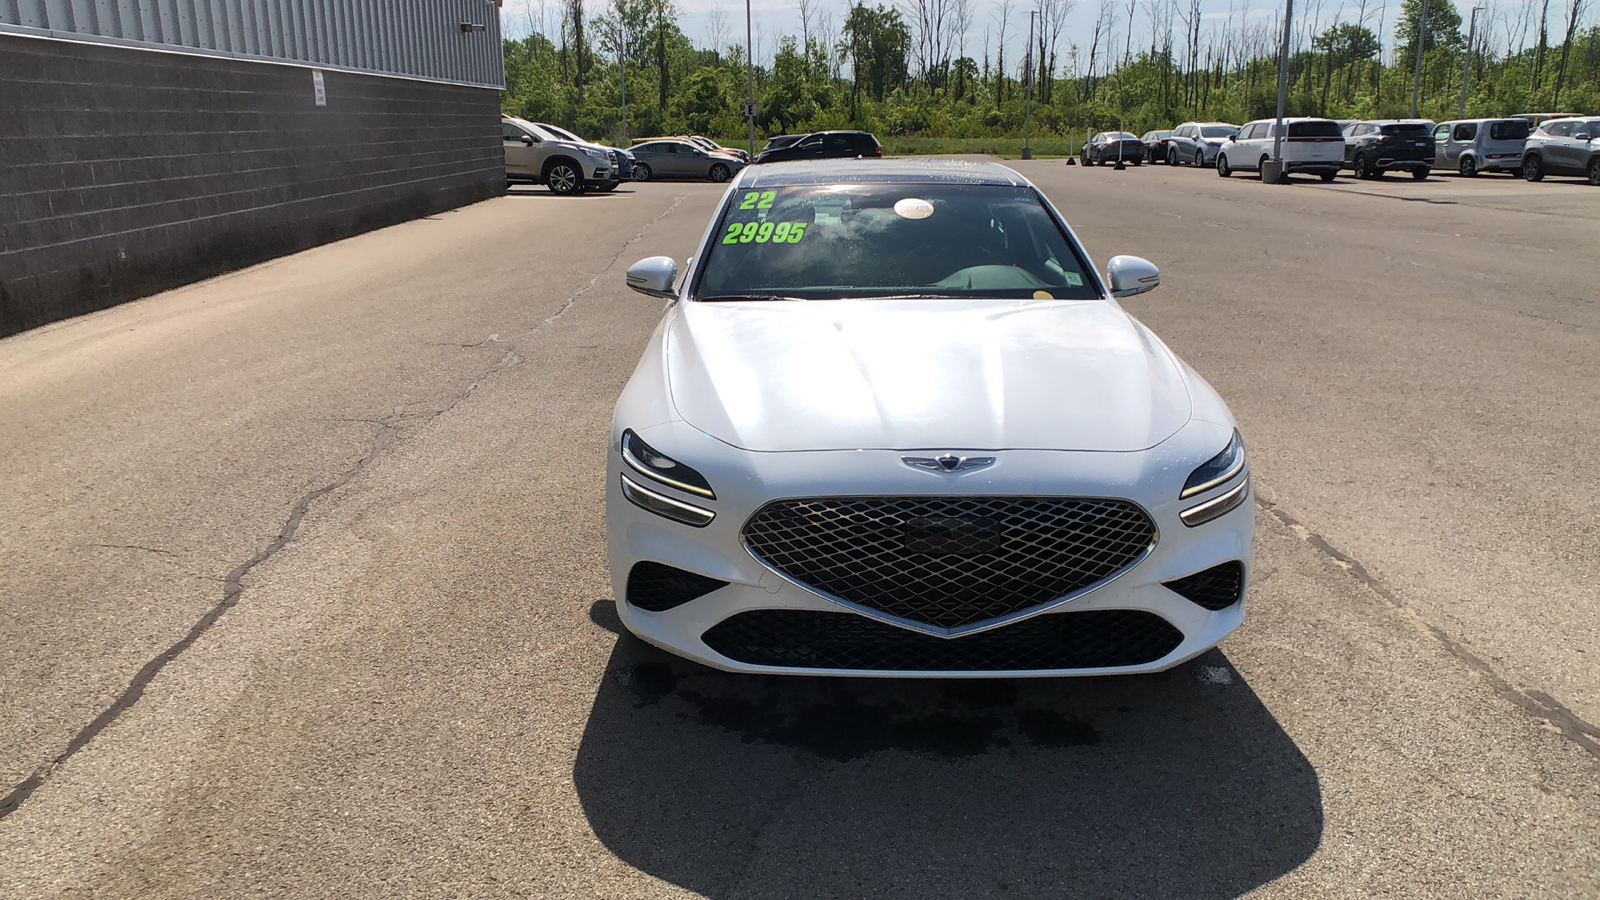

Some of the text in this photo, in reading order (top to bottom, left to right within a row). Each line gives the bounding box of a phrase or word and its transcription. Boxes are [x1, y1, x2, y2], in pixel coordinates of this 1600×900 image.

[748, 105, 754, 115] E
[740, 191, 776, 210] 22
[722, 222, 807, 244] 29995
